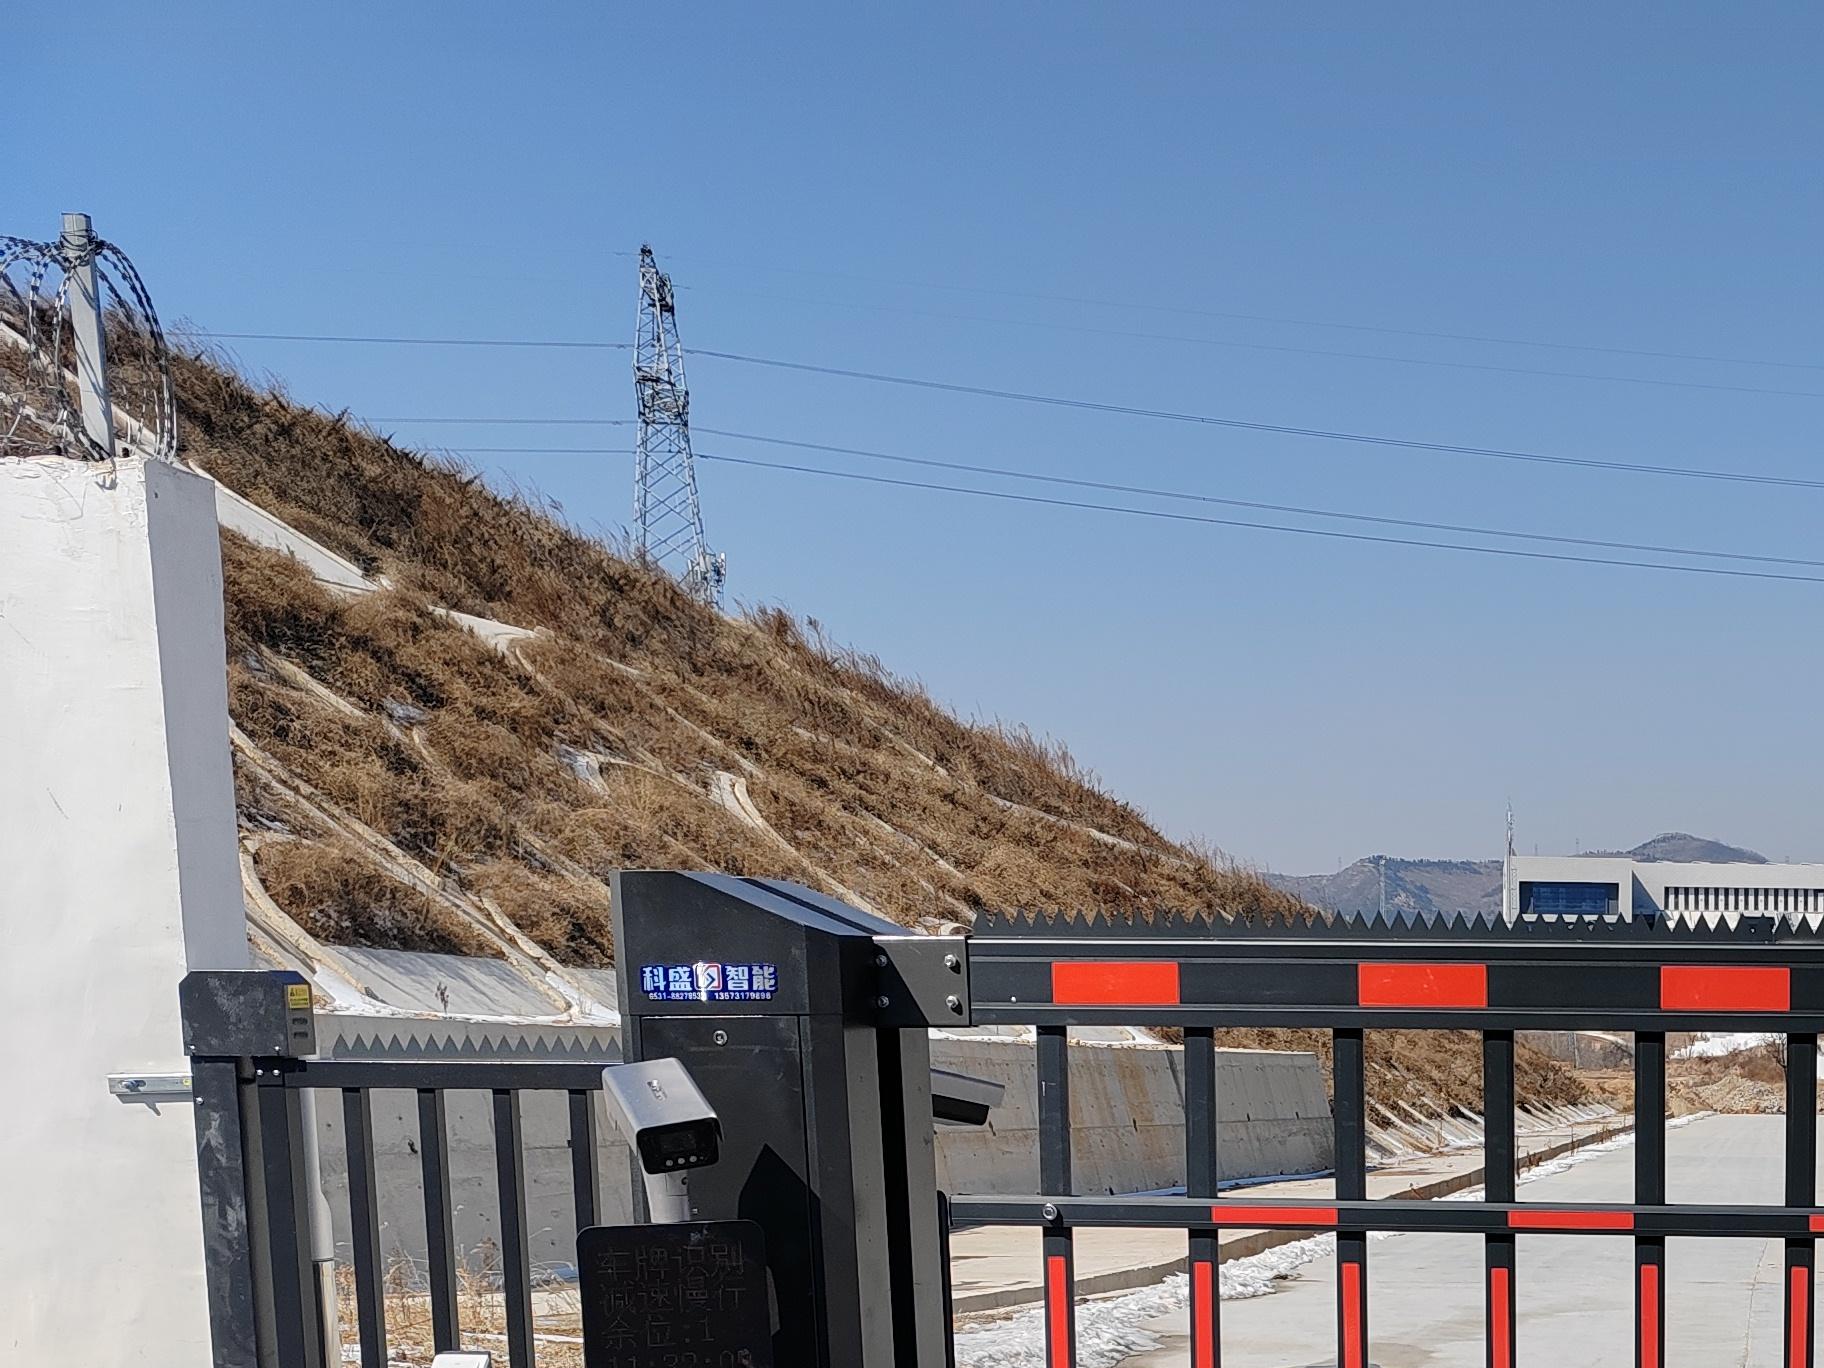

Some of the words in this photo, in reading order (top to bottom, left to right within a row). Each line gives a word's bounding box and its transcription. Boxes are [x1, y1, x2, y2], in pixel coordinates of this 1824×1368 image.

[642, 965, 693, 992] 科盛
[725, 964, 776, 992] 智能
[596, 1240, 744, 1281] 车牌识别
[599, 1276, 747, 1316] 减速慢行
